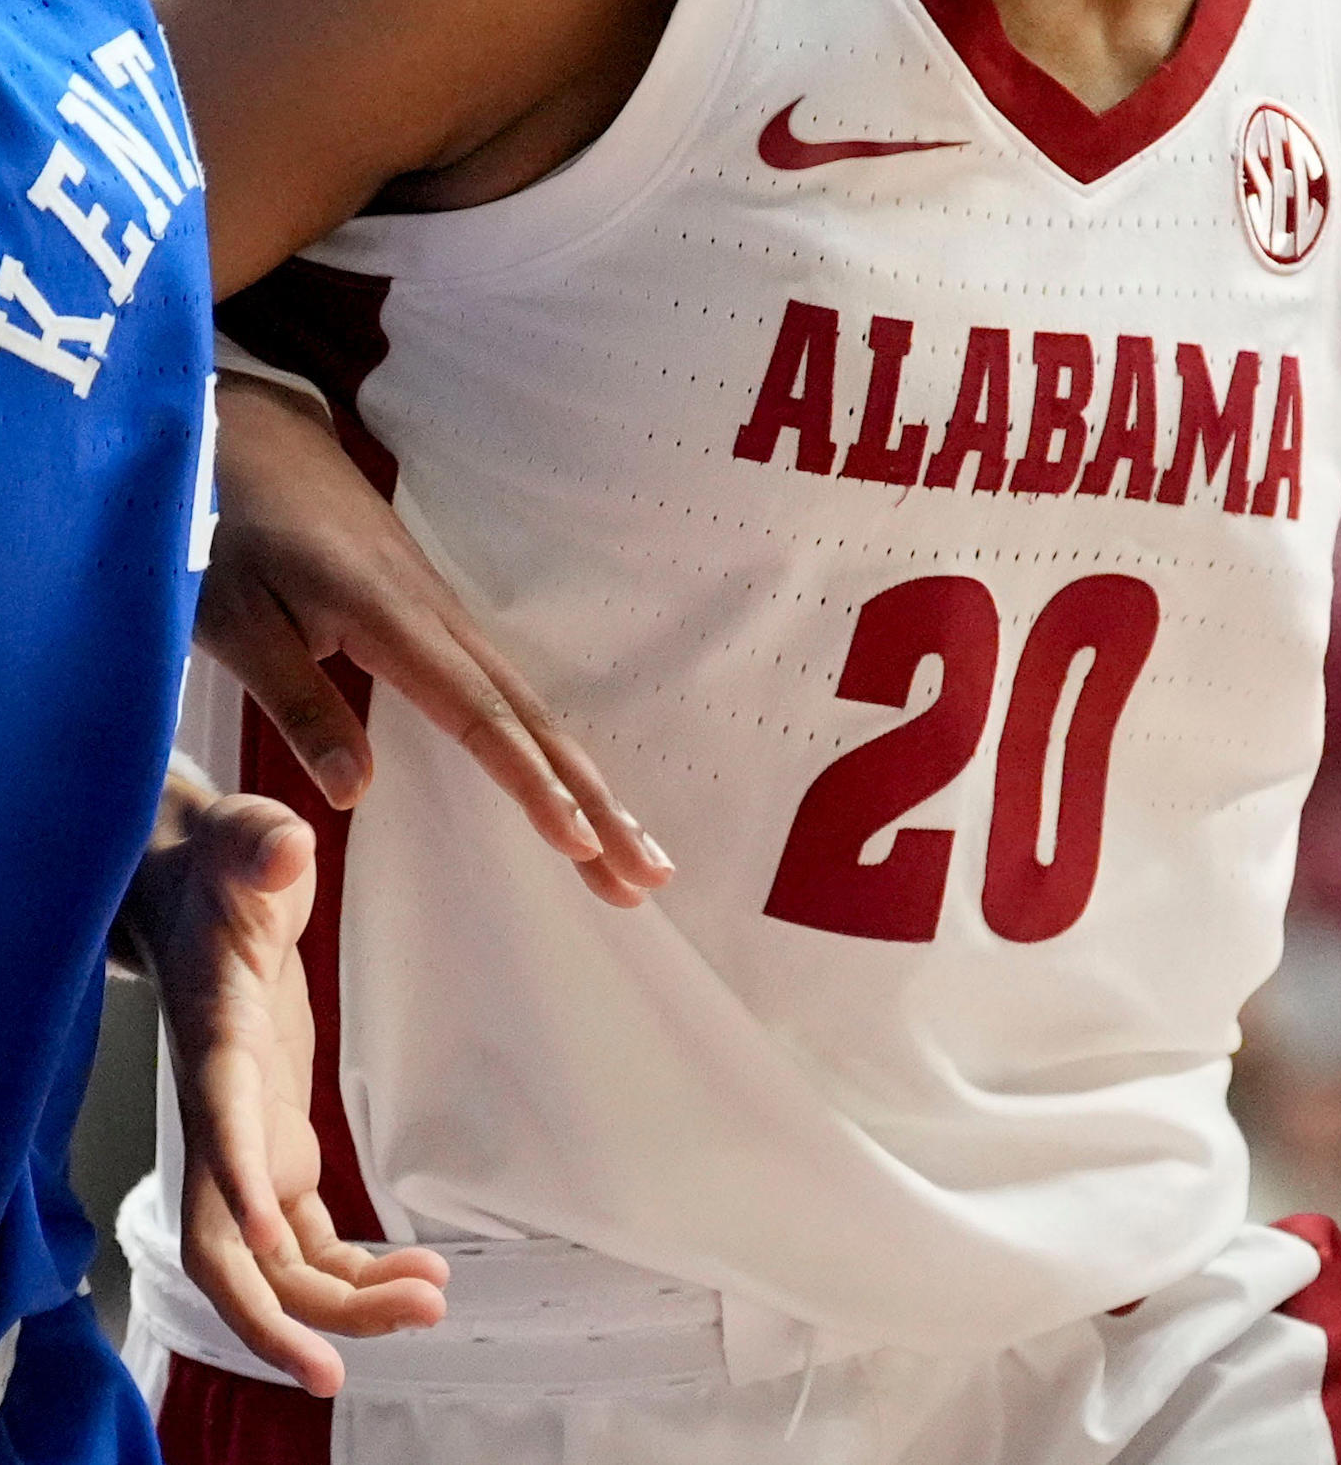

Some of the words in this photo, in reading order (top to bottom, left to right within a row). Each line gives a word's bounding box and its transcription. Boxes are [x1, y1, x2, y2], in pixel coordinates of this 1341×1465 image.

[1244, 103, 1328, 261] SEC
[733, 300, 1305, 521] ALABAMA
[763, 573, 1160, 944] 20
